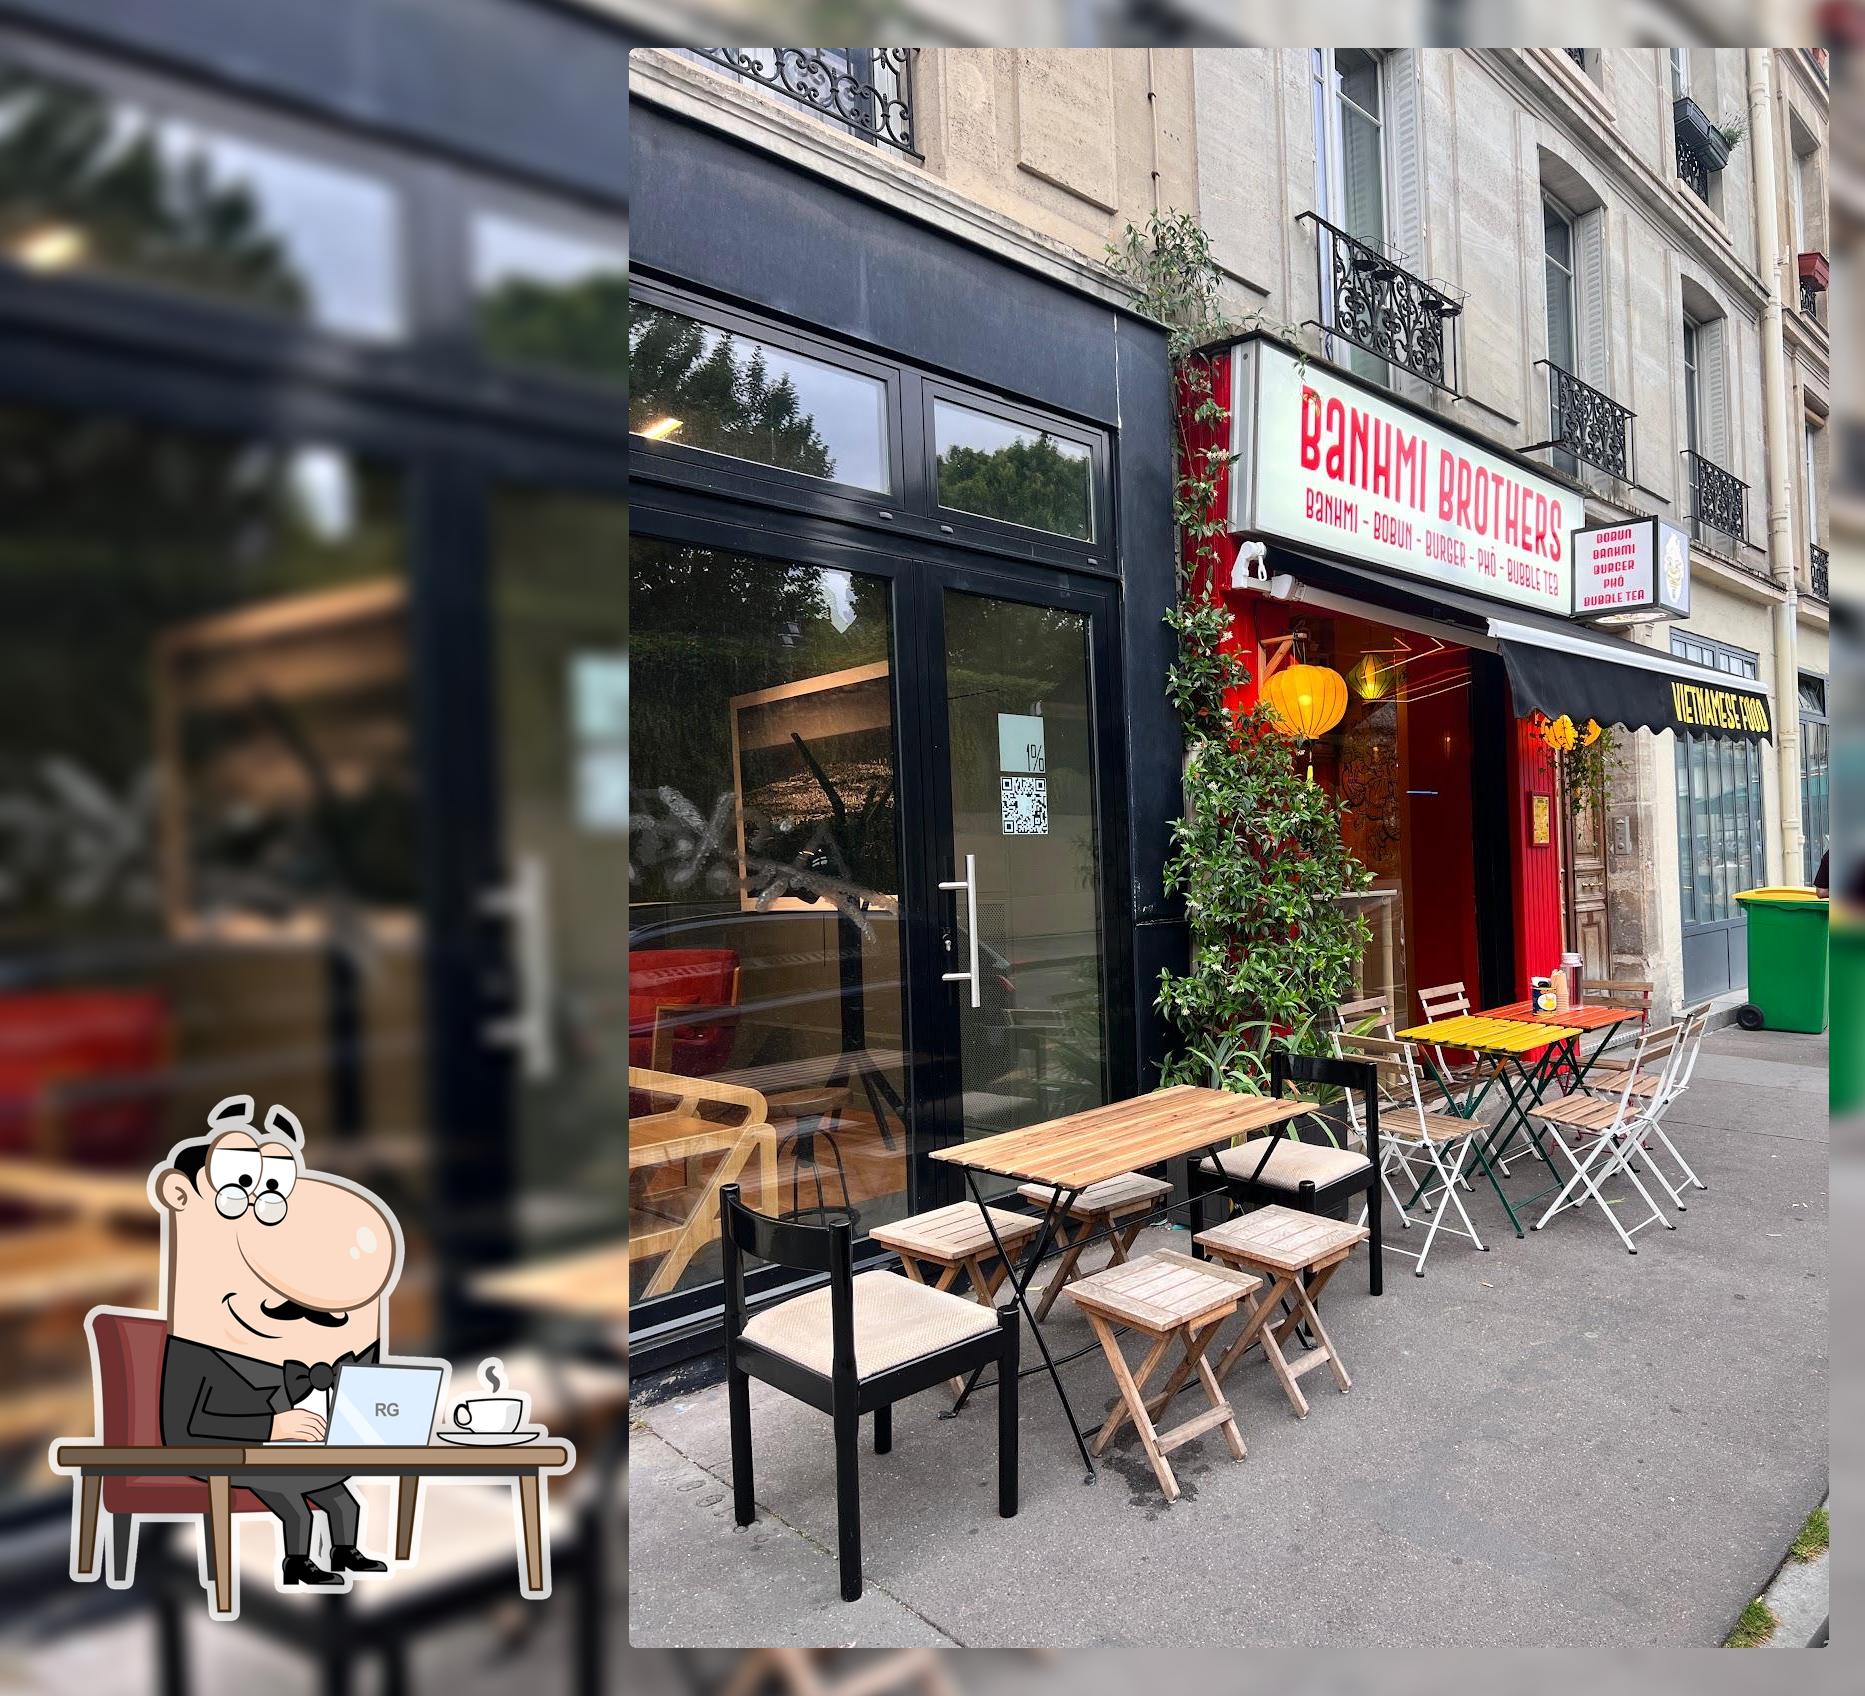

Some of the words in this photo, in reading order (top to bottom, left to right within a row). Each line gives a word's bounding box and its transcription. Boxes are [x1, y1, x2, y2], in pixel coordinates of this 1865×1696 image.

[1439, 448, 1562, 562] BROTHERS
[1596, 528, 1632, 544] BOBUN
[1374, 511, 1412, 550] BOBUN
[1425, 529, 1466, 568] BURGER
[1507, 558, 1541, 592] BUBBLE
[1593, 543, 1636, 560] BANHMI
[1593, 559, 1635, 575] BURGER
[1584, 591, 1623, 607] BUBBLE
[1626, 589, 1645, 602] TEA
[1671, 681, 1741, 730] VIETNAMESE
[1738, 695, 1769, 732] FOOD
